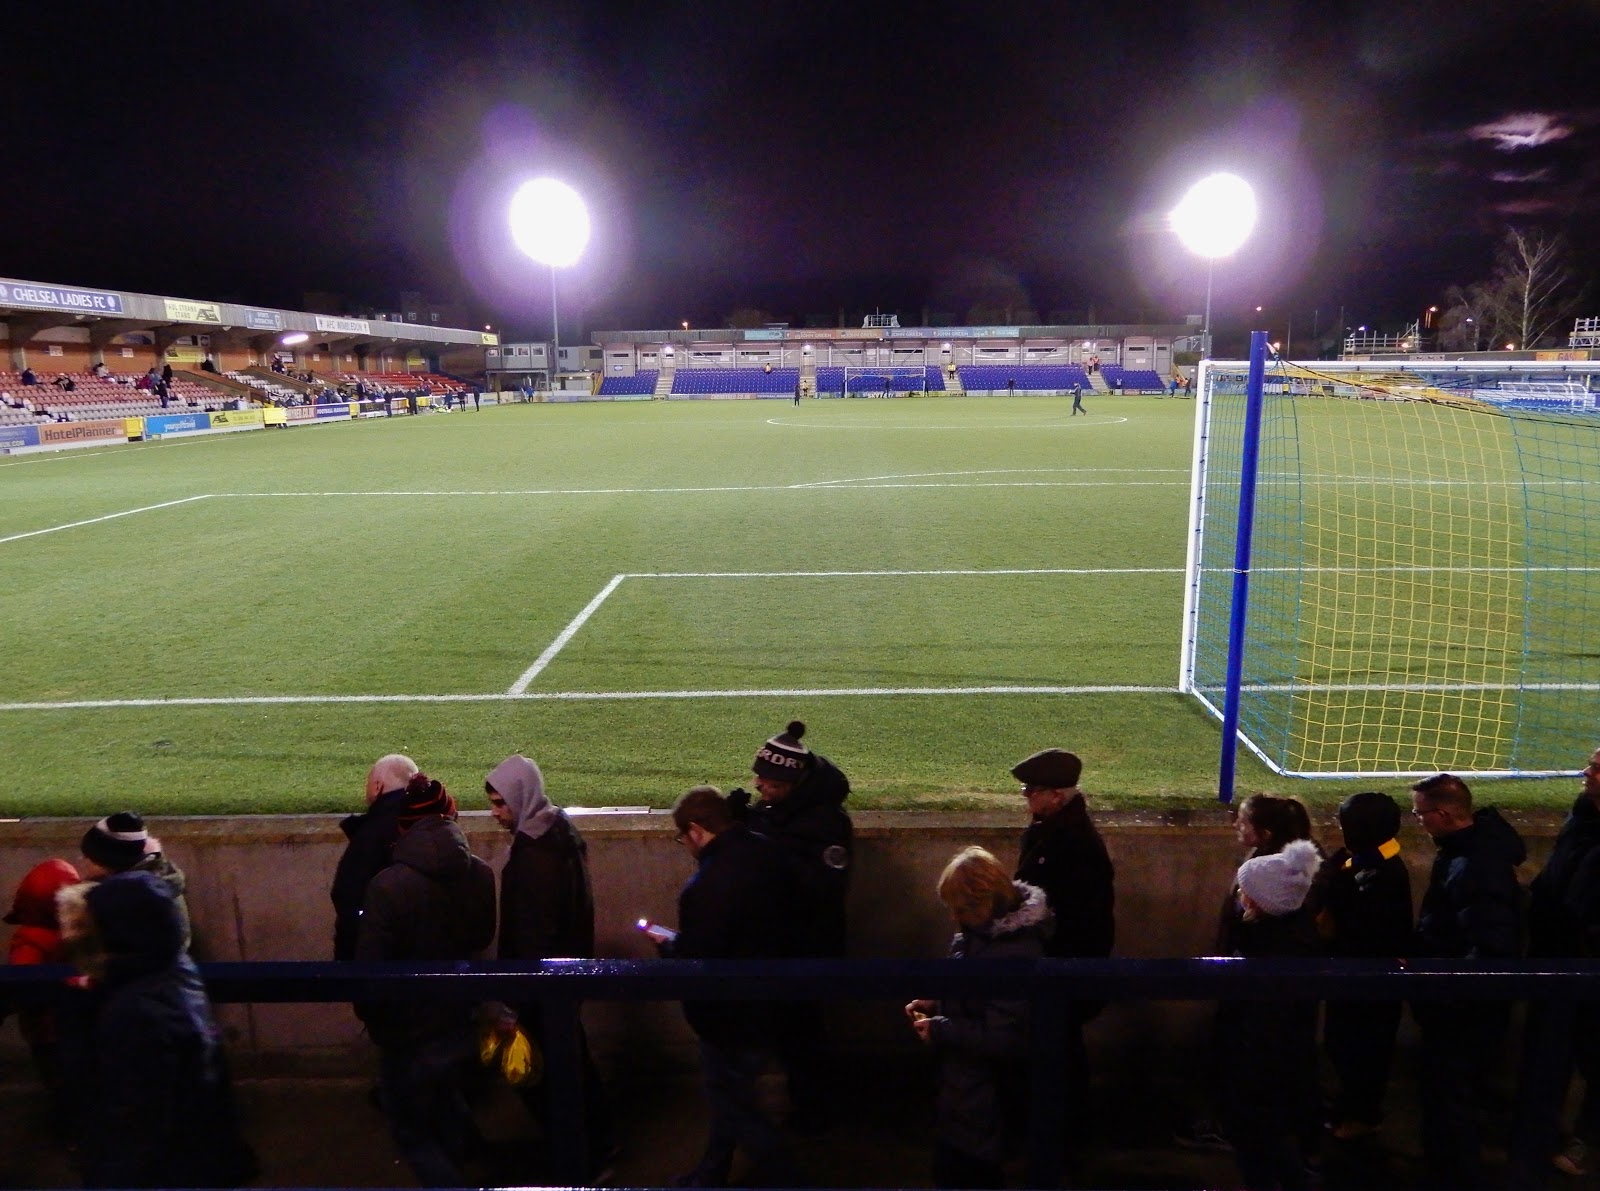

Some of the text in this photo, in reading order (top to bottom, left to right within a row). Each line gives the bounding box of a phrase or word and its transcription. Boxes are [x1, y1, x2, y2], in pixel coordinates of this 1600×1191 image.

[13, 288, 106, 308] CHELSEA LADIES FC
[326, 320, 363, 333] AFC WIMBLEDON
[45, 427, 116, 441] HotelPlanner
